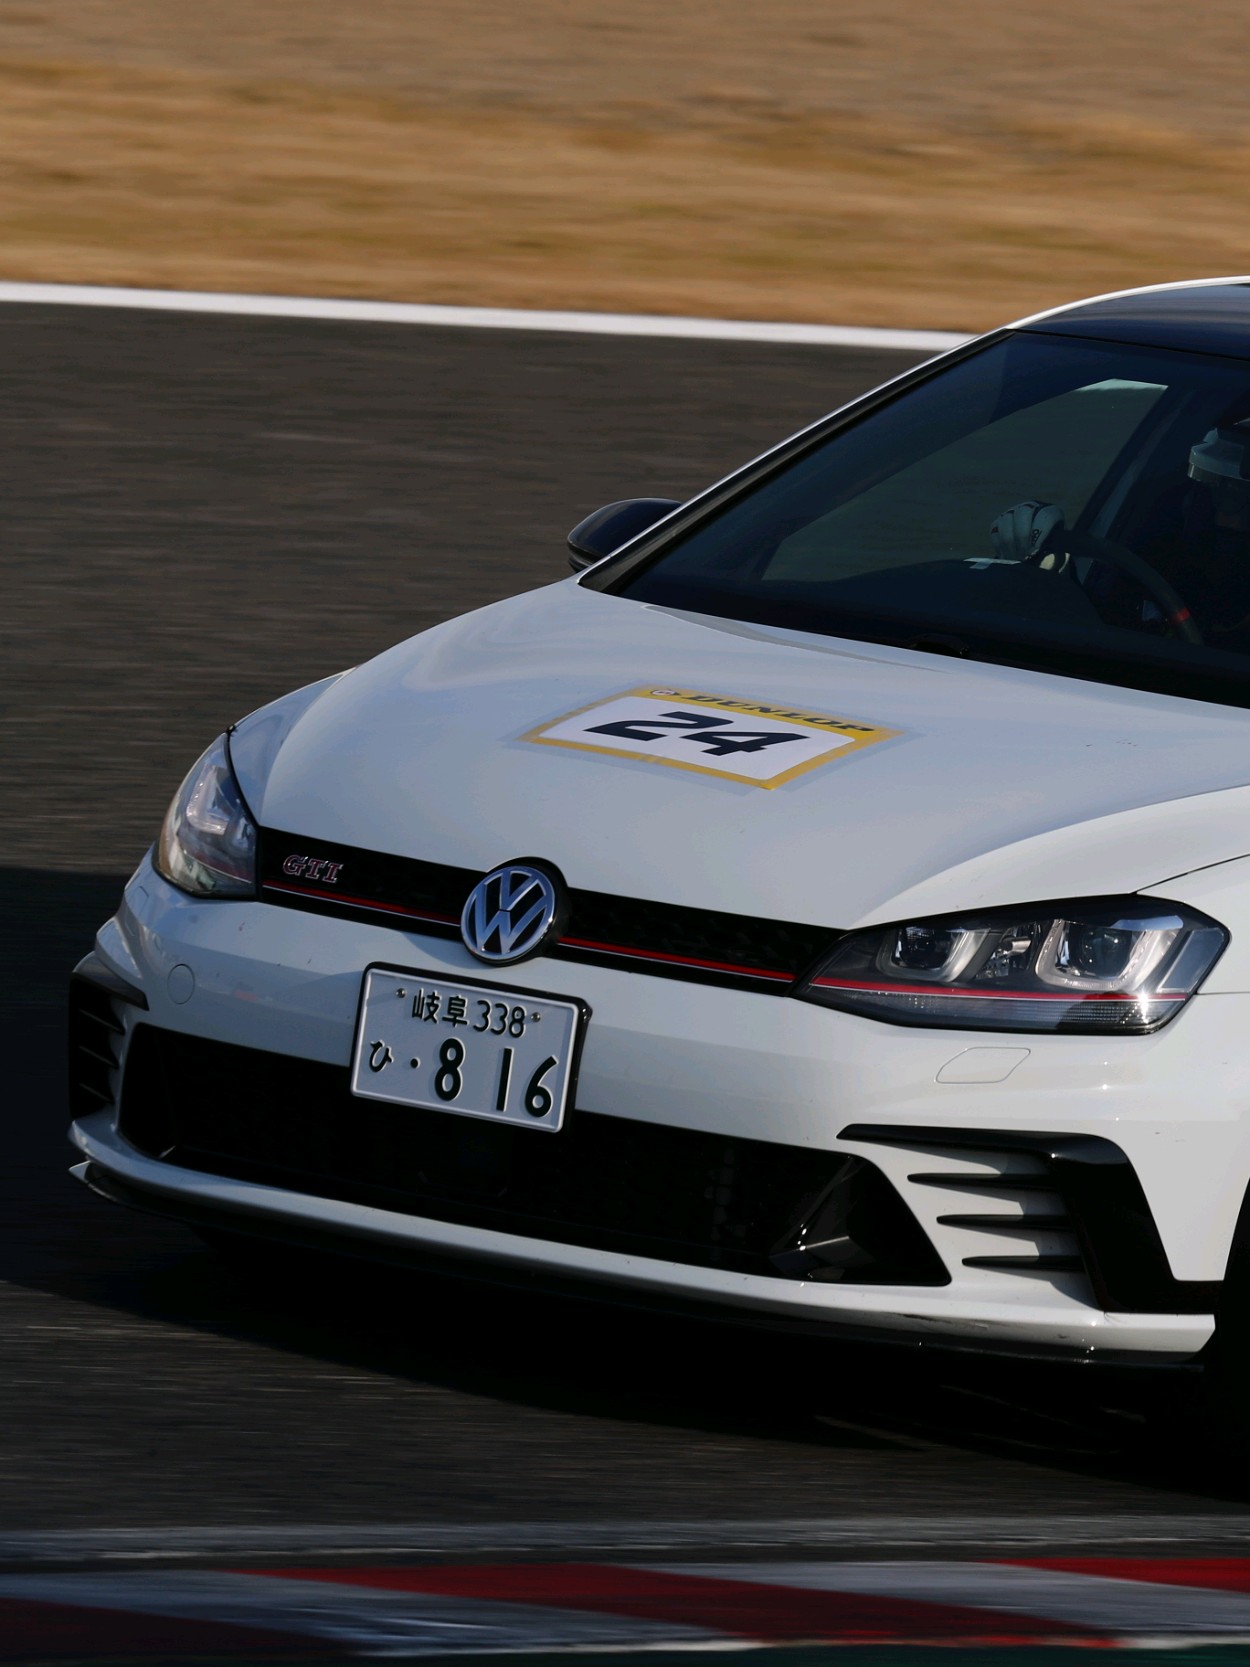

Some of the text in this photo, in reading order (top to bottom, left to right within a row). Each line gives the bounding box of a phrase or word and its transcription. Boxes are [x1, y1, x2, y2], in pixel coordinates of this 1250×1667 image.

[680, 695, 875, 732] DUNLOP
[583, 711, 810, 756] 24
[282, 854, 344, 884] GTI
